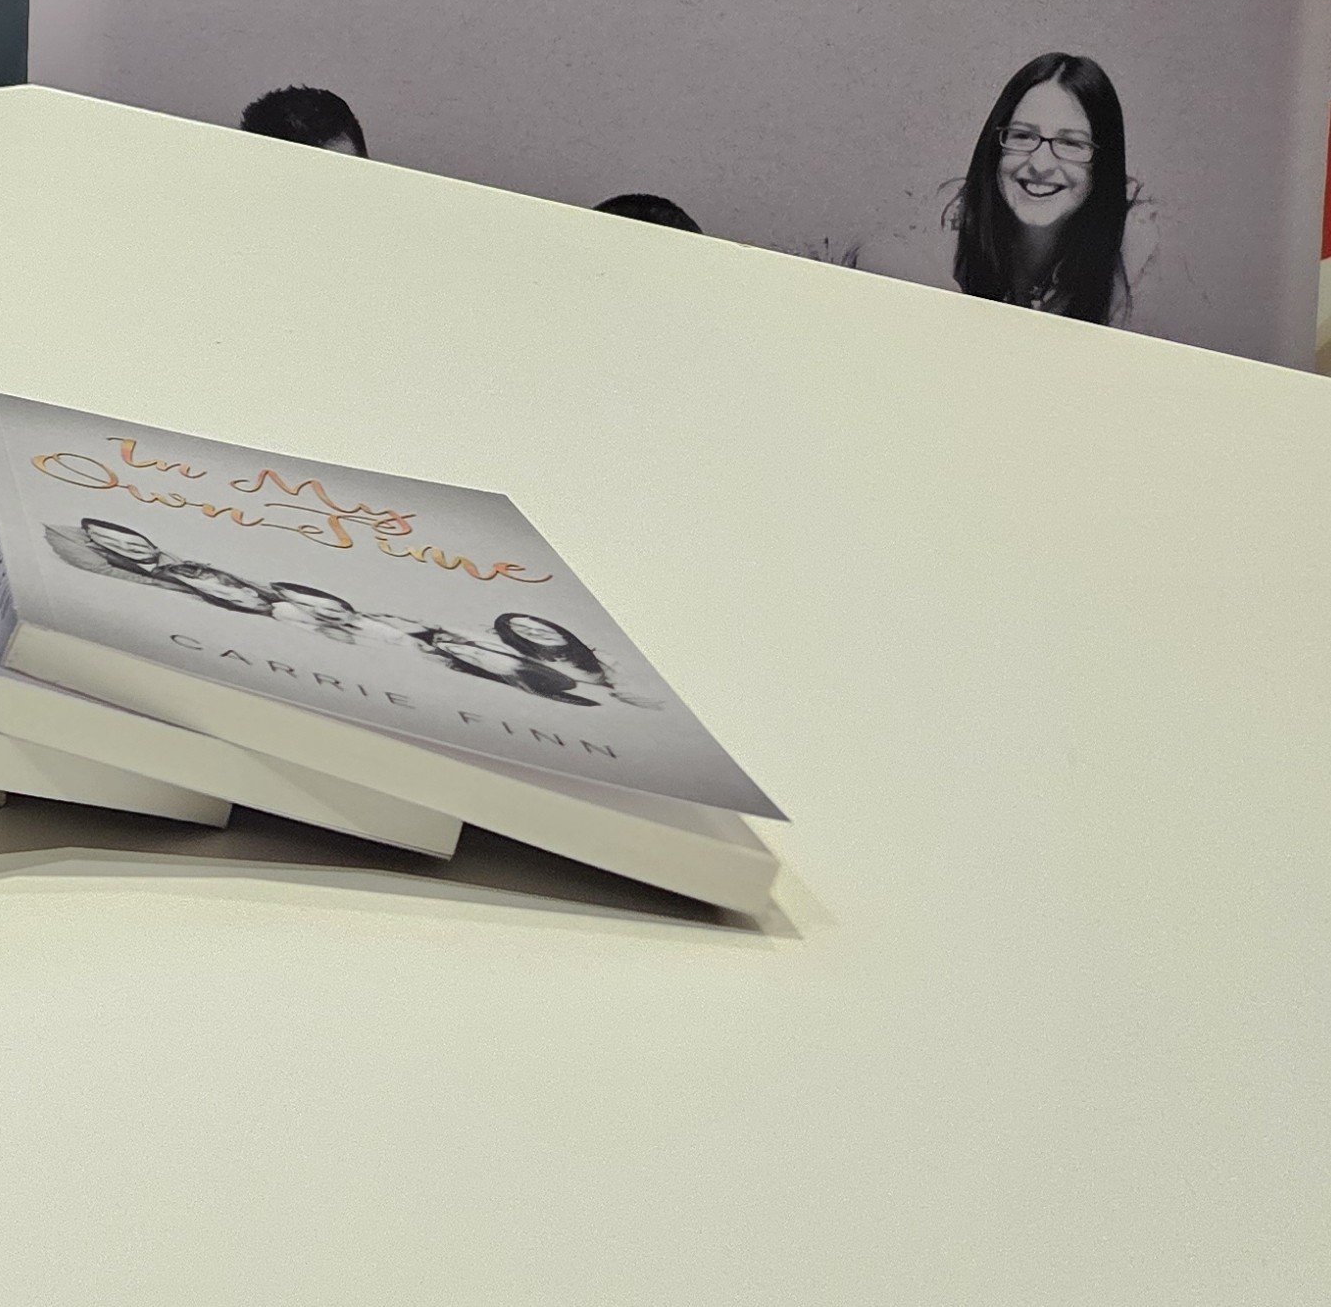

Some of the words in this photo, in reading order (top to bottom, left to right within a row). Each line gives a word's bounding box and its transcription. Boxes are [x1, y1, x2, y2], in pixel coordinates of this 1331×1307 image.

[31, 452, 264, 526] Own
[262, 502, 554, 584] Time
[106, 437, 208, 479] In
[230, 469, 417, 536] My
[169, 633, 417, 710] CARRIE
[456, 708, 619, 760] FINN
